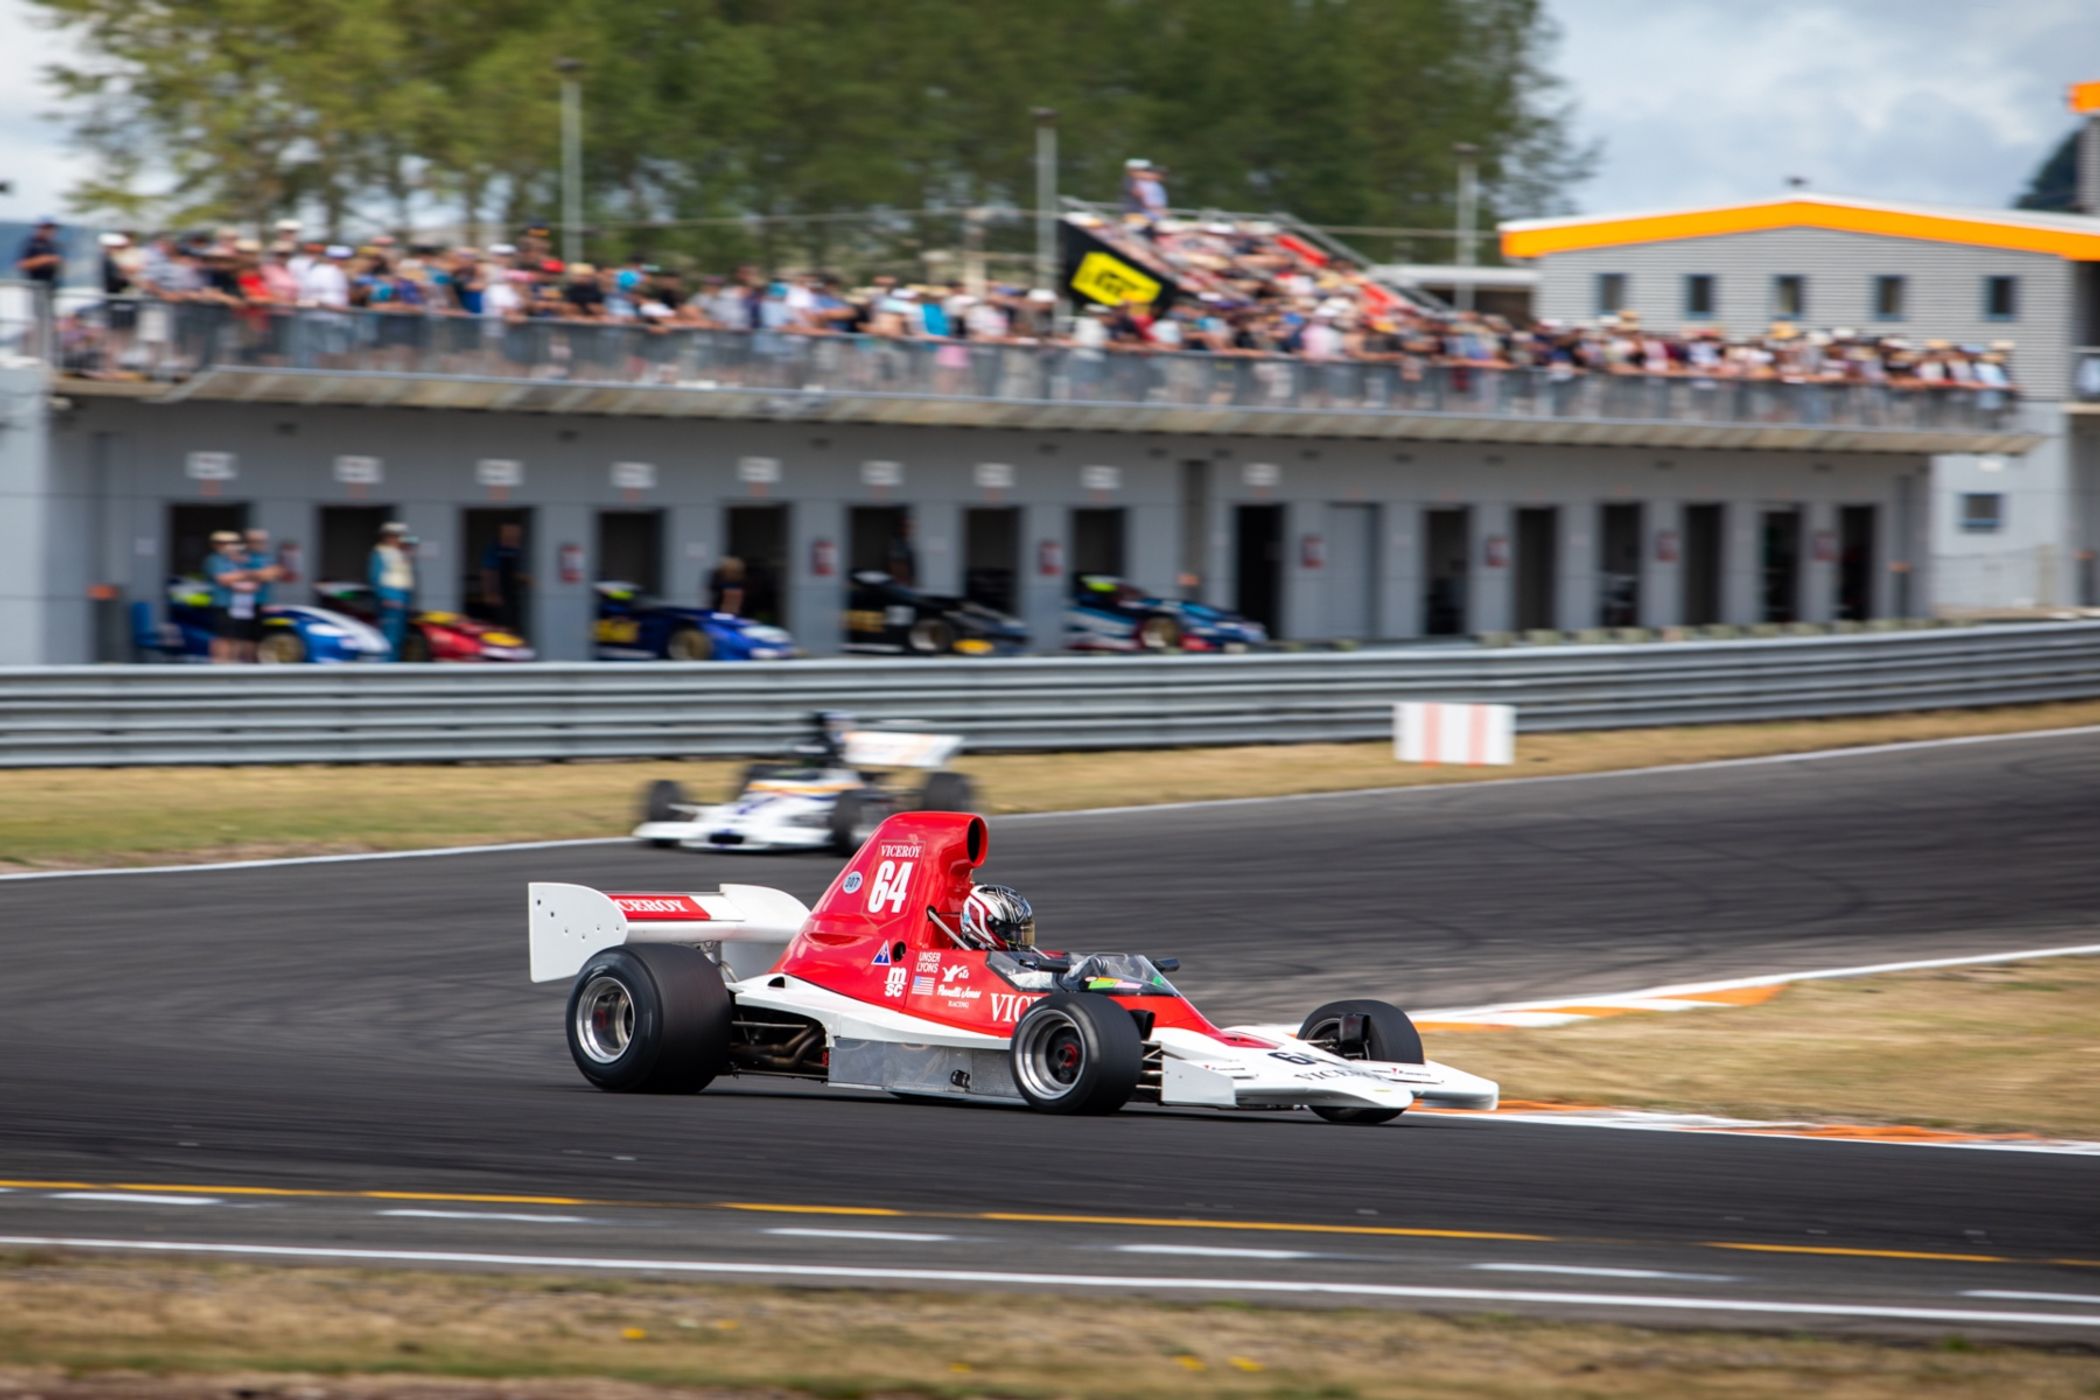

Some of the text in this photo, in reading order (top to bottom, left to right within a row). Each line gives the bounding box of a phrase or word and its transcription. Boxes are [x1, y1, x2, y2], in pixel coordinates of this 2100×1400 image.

[881, 845, 922, 858] VICEROY
[868, 860, 913, 913] 64
[612, 900, 689, 912] CEROY
[990, 993, 1043, 1023] VIC
